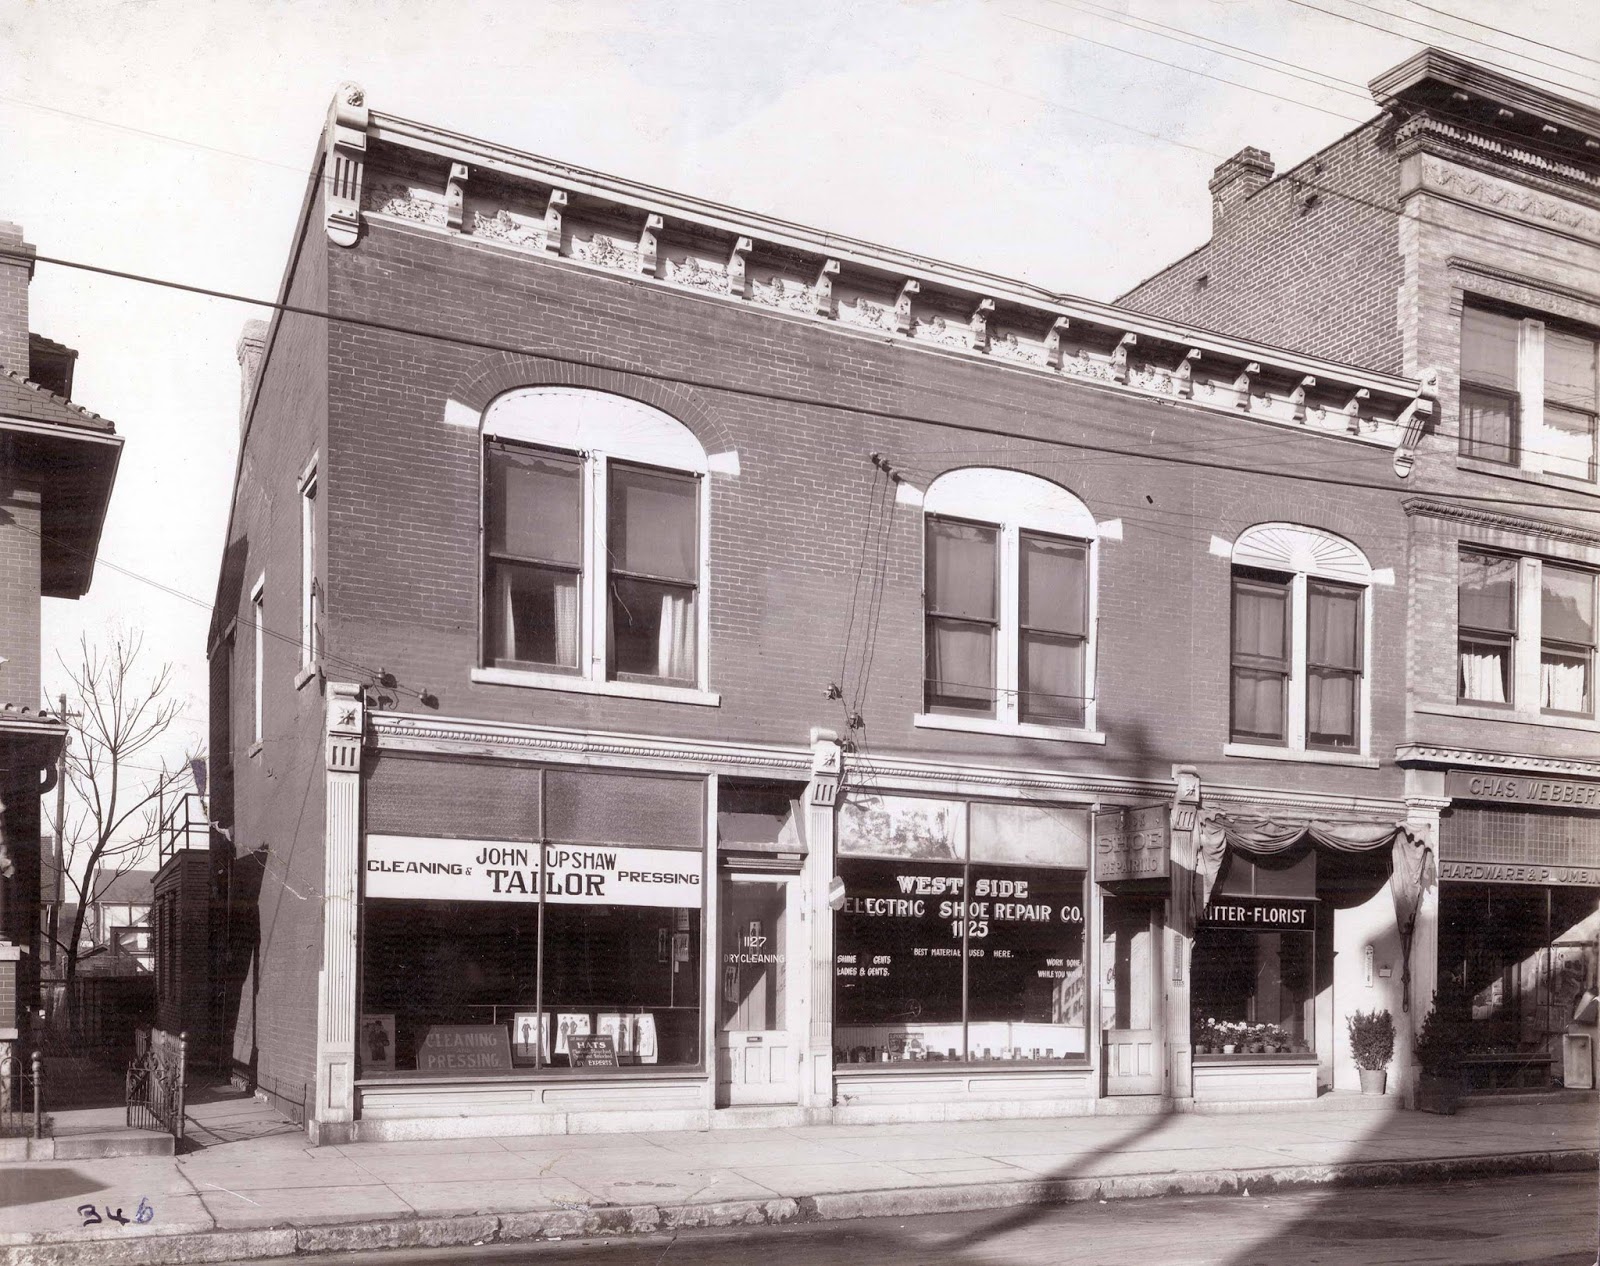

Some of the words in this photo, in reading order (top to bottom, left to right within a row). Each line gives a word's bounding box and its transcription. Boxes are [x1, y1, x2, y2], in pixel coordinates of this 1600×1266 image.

[1469, 777, 1519, 799] CHAS.
[1526, 782, 1600, 805] WEBBER
[1098, 833, 1163, 854] SHOE
[367, 859, 463, 875] CLEANING
[465, 867, 473, 876] &
[547, 850, 617, 870] UPSHAW
[1102, 859, 1158, 876] REPAIRING
[617, 870, 700, 885] PRESSING
[1439, 863, 1525, 882] HARDWARE
[1527, 867, 1537, 881] &
[486, 869, 606, 896] TAILOR
[897, 875, 964, 895] WEST
[975, 878, 1029, 899] SIDE
[843, 897, 926, 918] ELECTRIC
[939, 900, 990, 919] SHOE
[994, 903, 1052, 922] REPAIR
[1060, 905, 1083, 923] CO.
[951, 920, 989, 938] 1125
[744, 936, 767, 947] 1127
[913, 947, 928, 956] BEST
[931, 948, 961, 957] MATERIAL
[968, 949, 985, 957] USED
[426, 1033, 498, 1049] CLEANING
[576, 1041, 607, 1049] HATS
